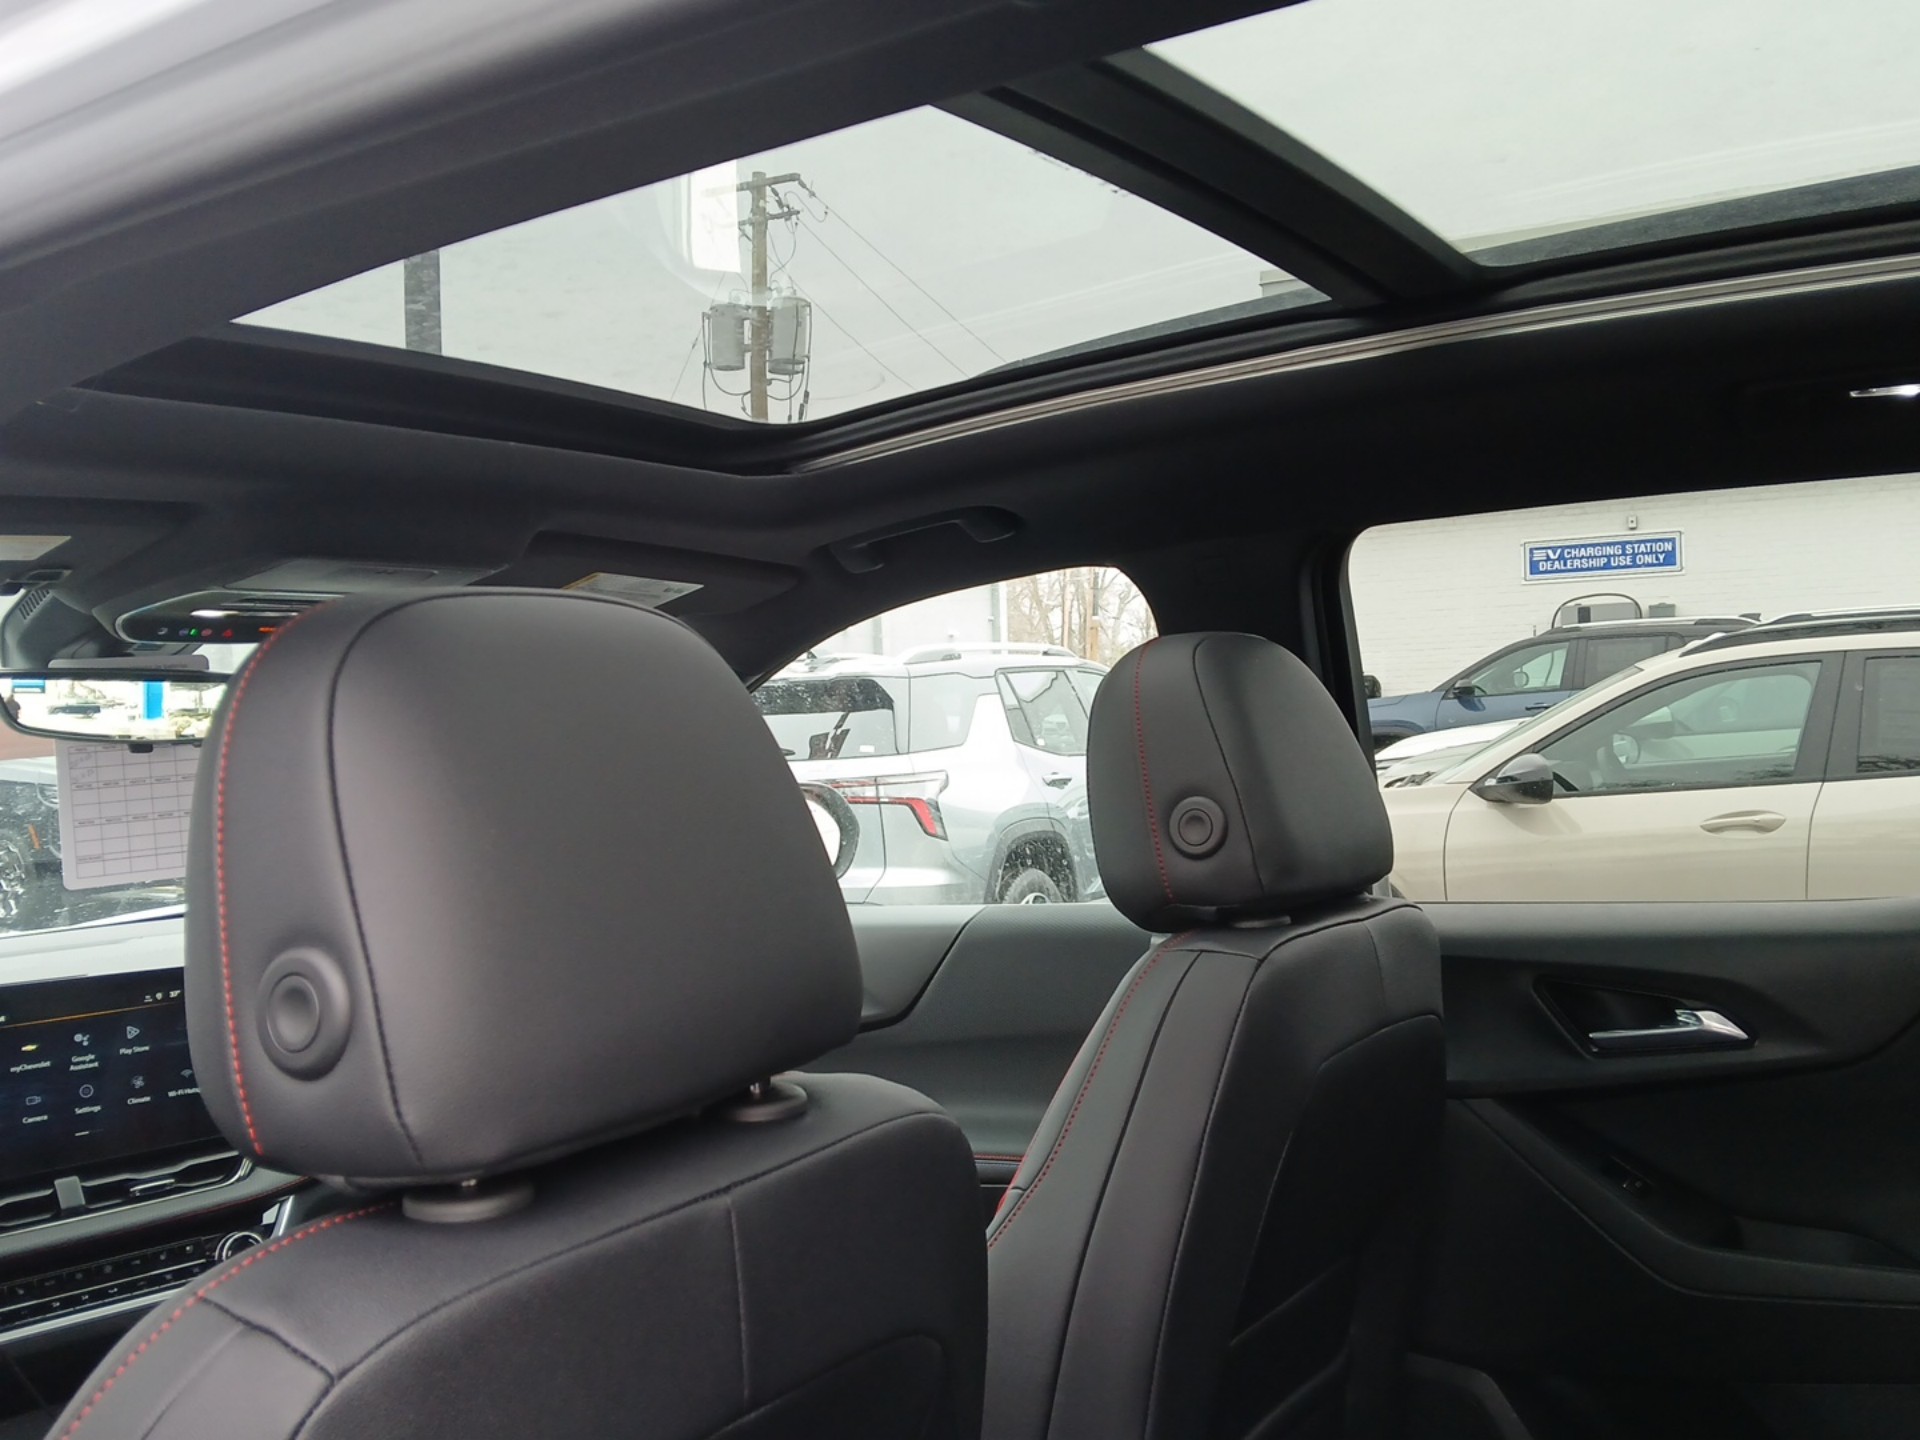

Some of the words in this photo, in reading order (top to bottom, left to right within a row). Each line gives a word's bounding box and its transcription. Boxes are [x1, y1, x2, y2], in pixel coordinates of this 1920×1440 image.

[1532, 548, 1562, 561] EV
[1564, 544, 1622, 558] CHARGING
[1625, 541, 1673, 554] STATION
[1539, 556, 1608, 571] DEALERSHIP
[1610, 555, 1633, 566] USE
[1635, 552, 1666, 565] ONLY
